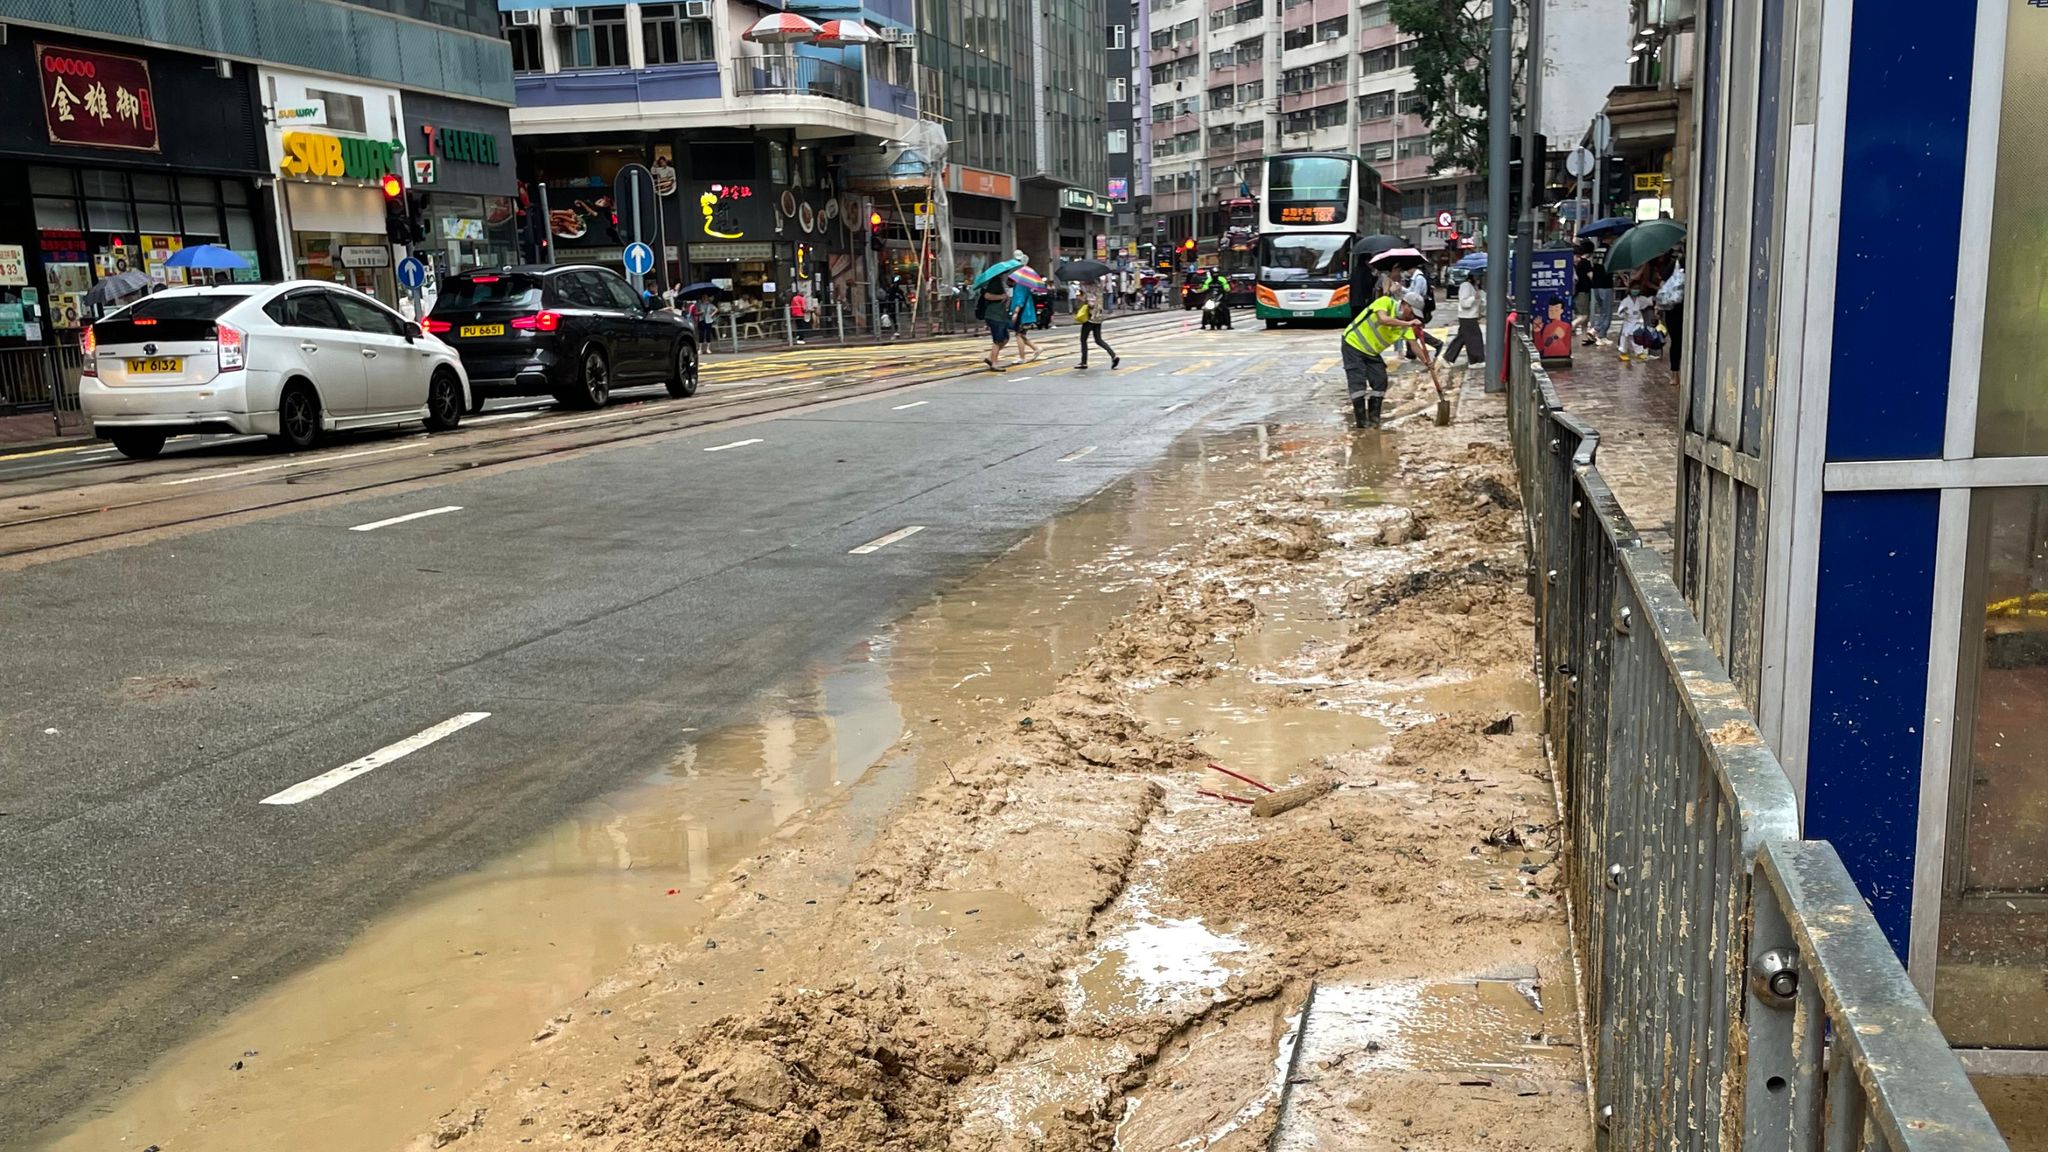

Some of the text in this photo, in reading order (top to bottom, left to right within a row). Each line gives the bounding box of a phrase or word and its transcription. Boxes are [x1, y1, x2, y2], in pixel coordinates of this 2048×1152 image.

[278, 108, 318, 119] SUBWAY
[280, 131, 405, 179] SUBWAY
[463, 326, 501, 336] PU 6651
[132, 360, 177, 372] VT 6132
